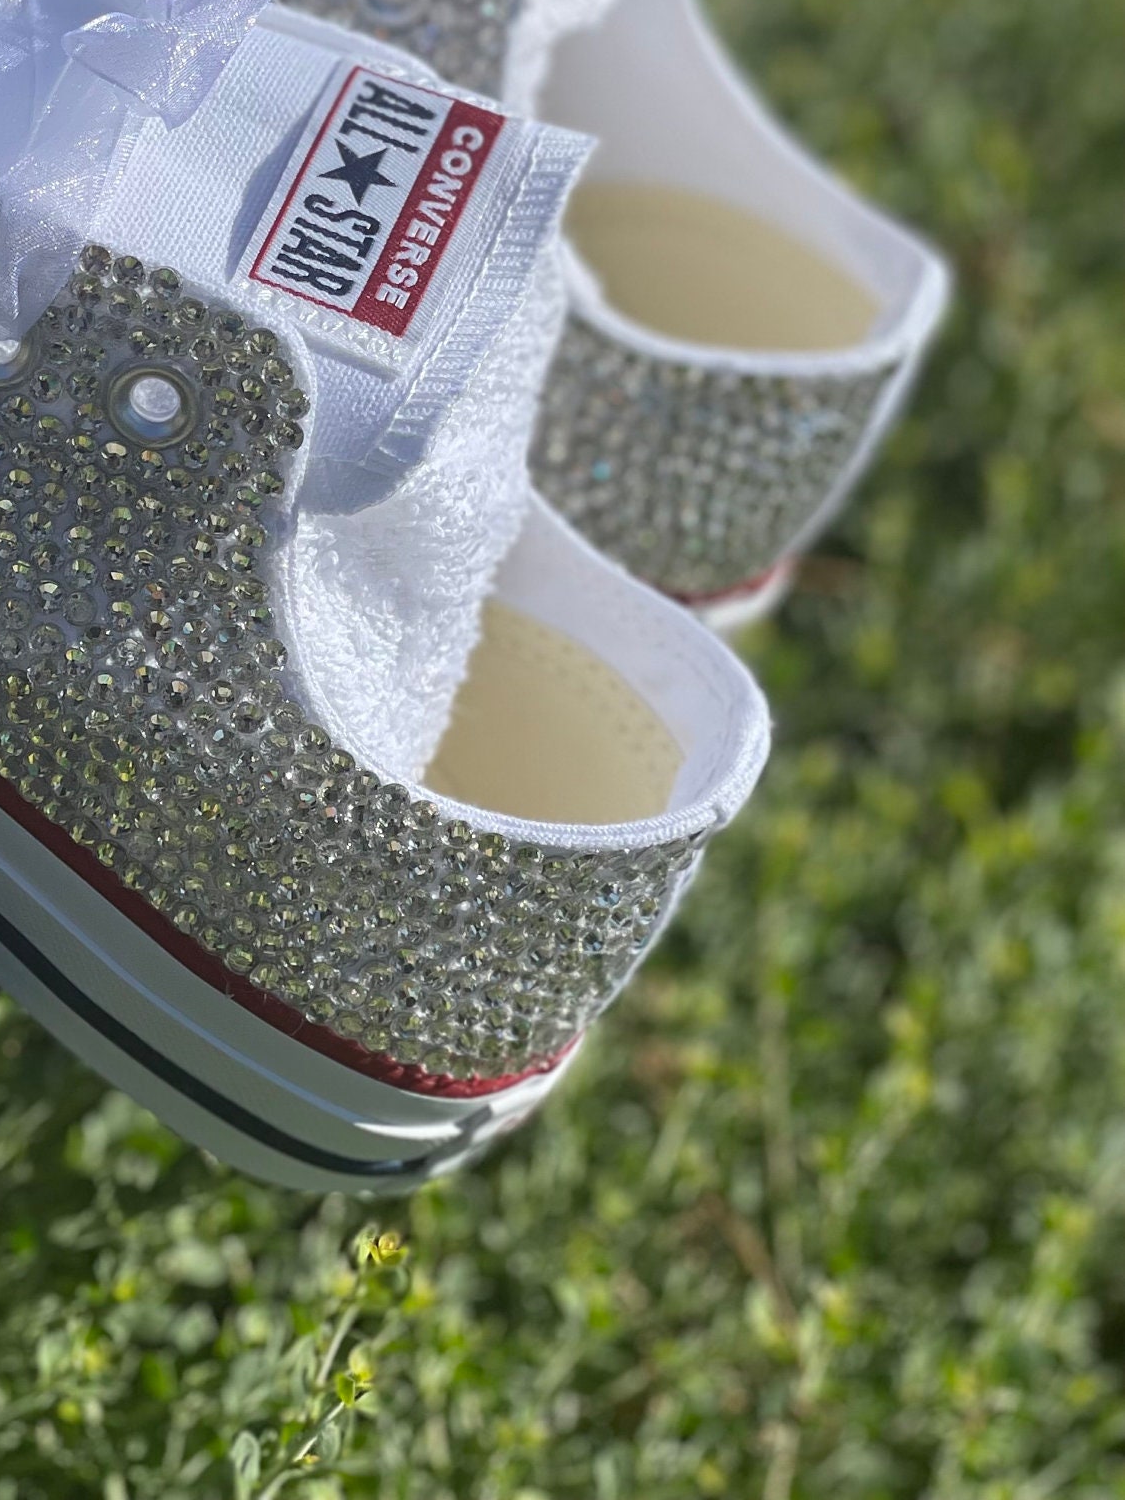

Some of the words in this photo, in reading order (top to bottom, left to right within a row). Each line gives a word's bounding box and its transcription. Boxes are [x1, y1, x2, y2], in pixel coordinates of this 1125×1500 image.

[339, 80, 436, 153] ALL
[271, 193, 381, 297] STAR
[376, 127, 484, 310] CONVERSE
